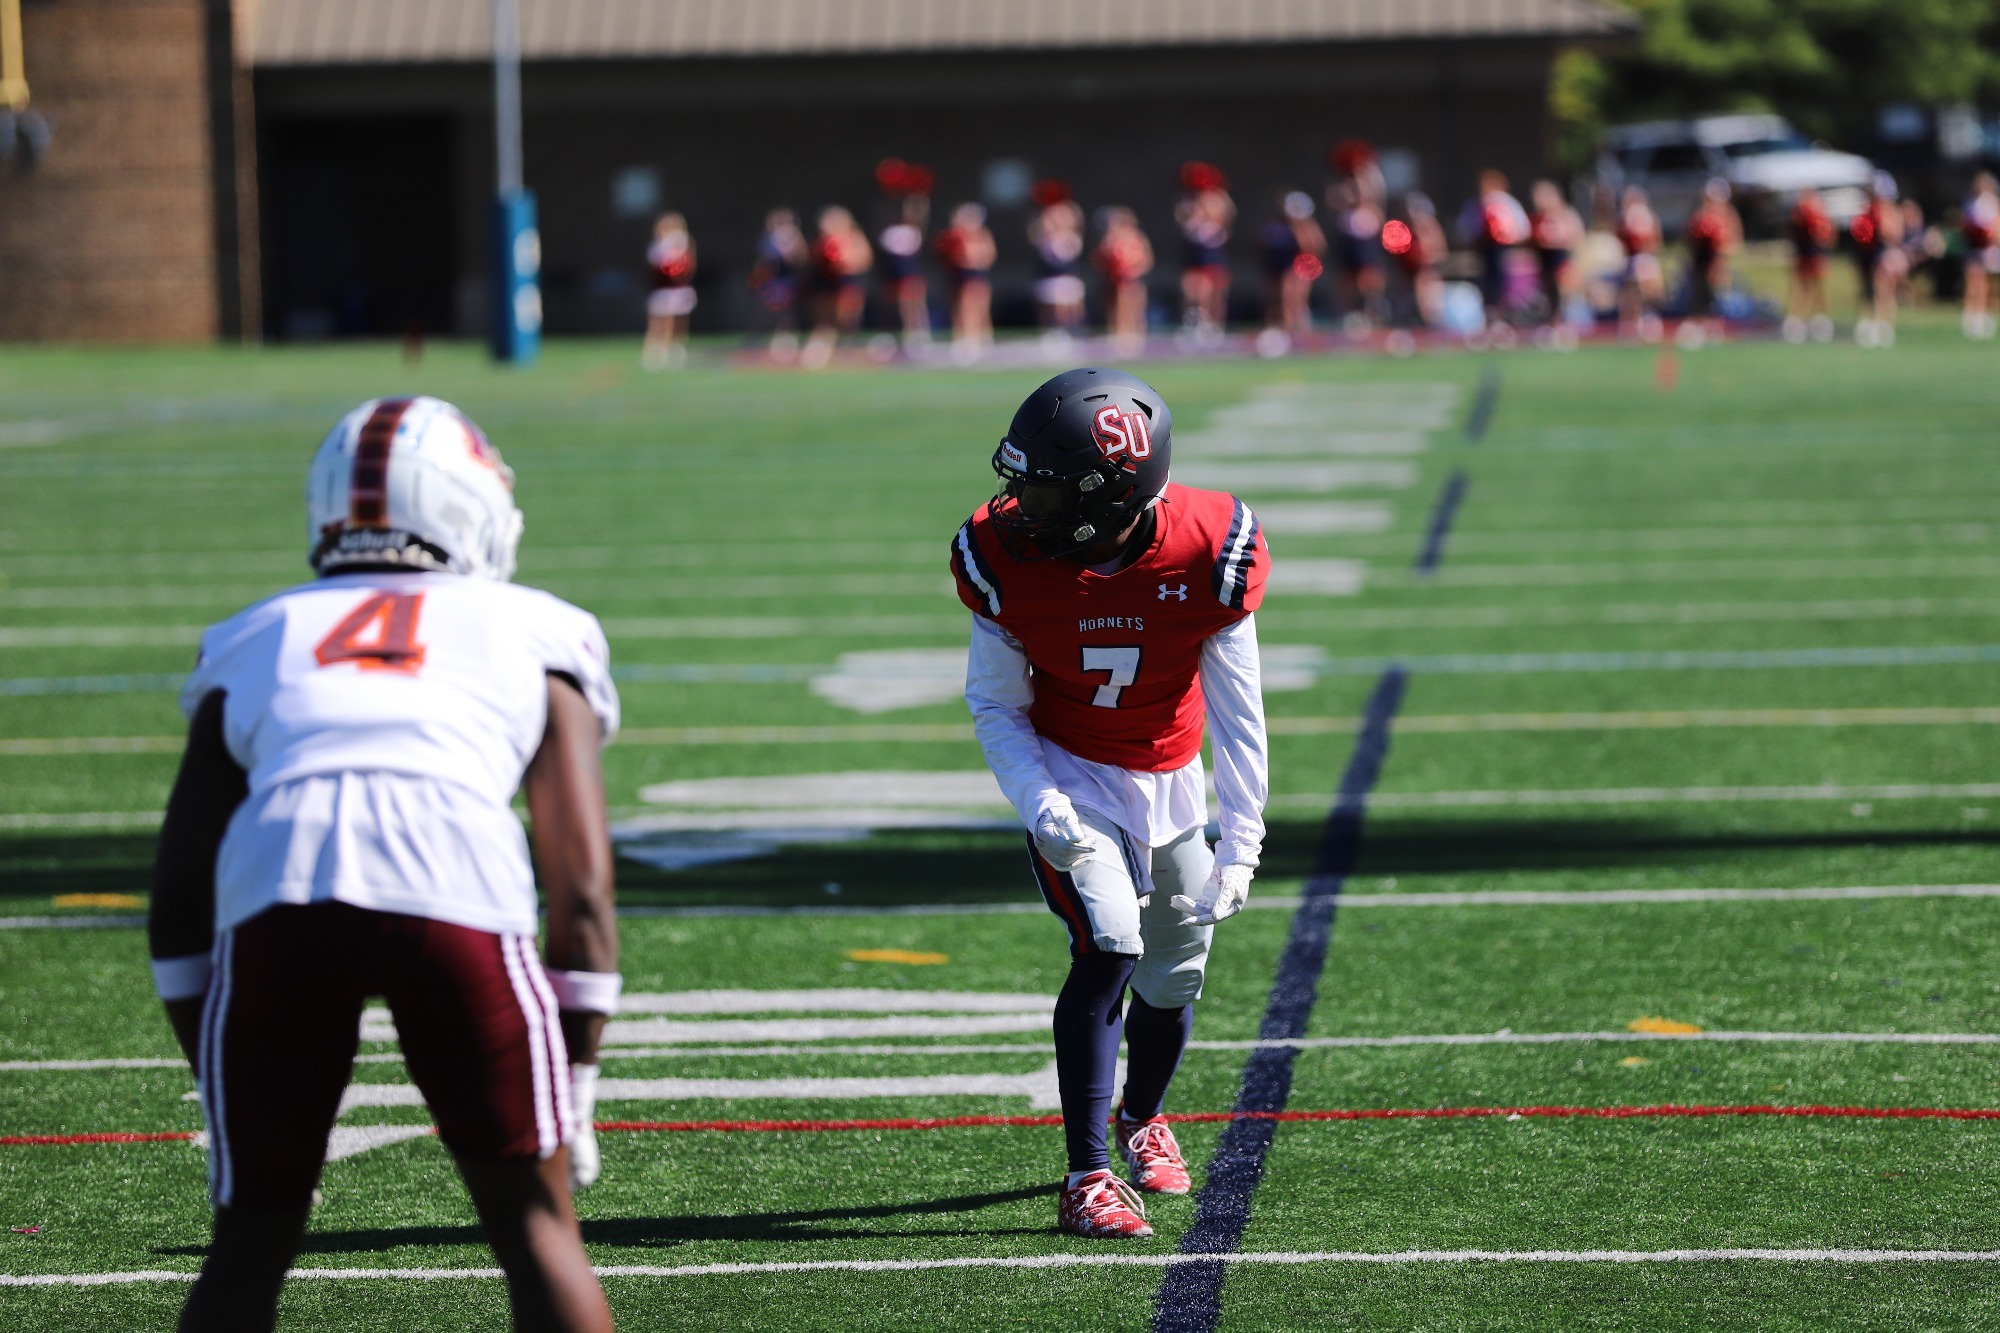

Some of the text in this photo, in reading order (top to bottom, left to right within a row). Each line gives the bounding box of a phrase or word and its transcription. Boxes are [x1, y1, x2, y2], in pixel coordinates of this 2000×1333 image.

[1094, 405, 1152, 462] SU
[314, 590, 425, 676] 4
[1079, 616, 1144, 632] HORNETS
[1081, 646, 1141, 709] 7
